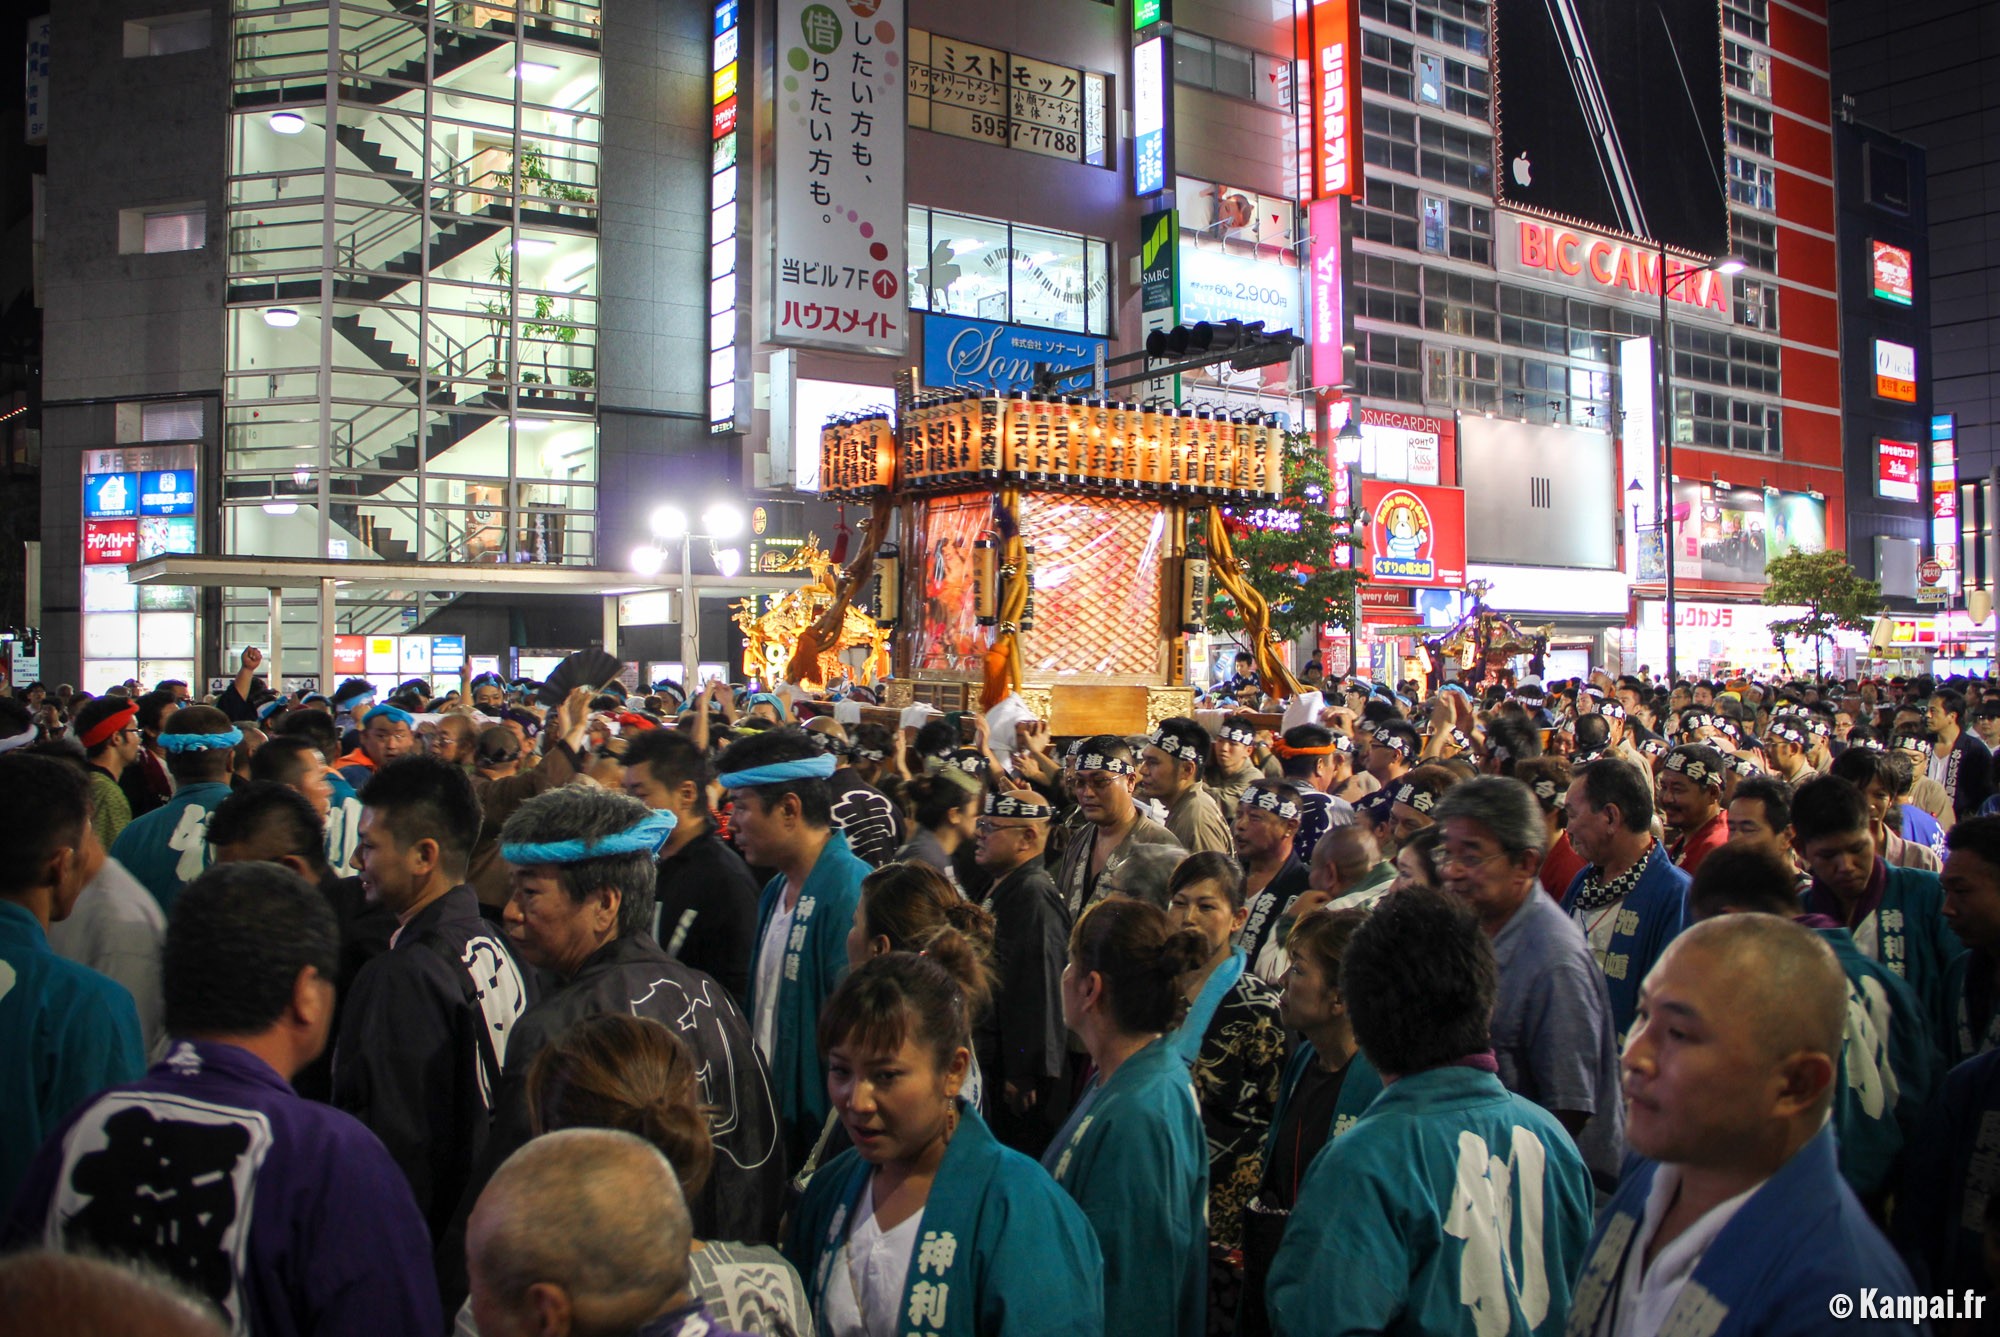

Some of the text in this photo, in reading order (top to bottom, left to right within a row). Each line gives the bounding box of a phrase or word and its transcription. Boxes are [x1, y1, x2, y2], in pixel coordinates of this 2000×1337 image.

[943, 46, 1077, 98] ミストモック
[806, 9, 837, 224] 借りたい方も。
[971, 114, 1077, 154] 5957-7788
[1321, 43, 1346, 192] ビックカメラ
[782, 258, 869, 291] 当ビル7F
[1143, 267, 1170, 285] SMBC
[1520, 221, 1727, 312] BIC CAMERA
[782, 300, 897, 339] ハウスメイト
[1011, 337, 1087, 358] 株式会社 ソナーレ
[1408, 437, 1435, 449] ROHTO
[161, 506, 174, 514] 10F
[1384, 592, 1399, 603] day!
[906, 1230, 957, 1337] 神利
